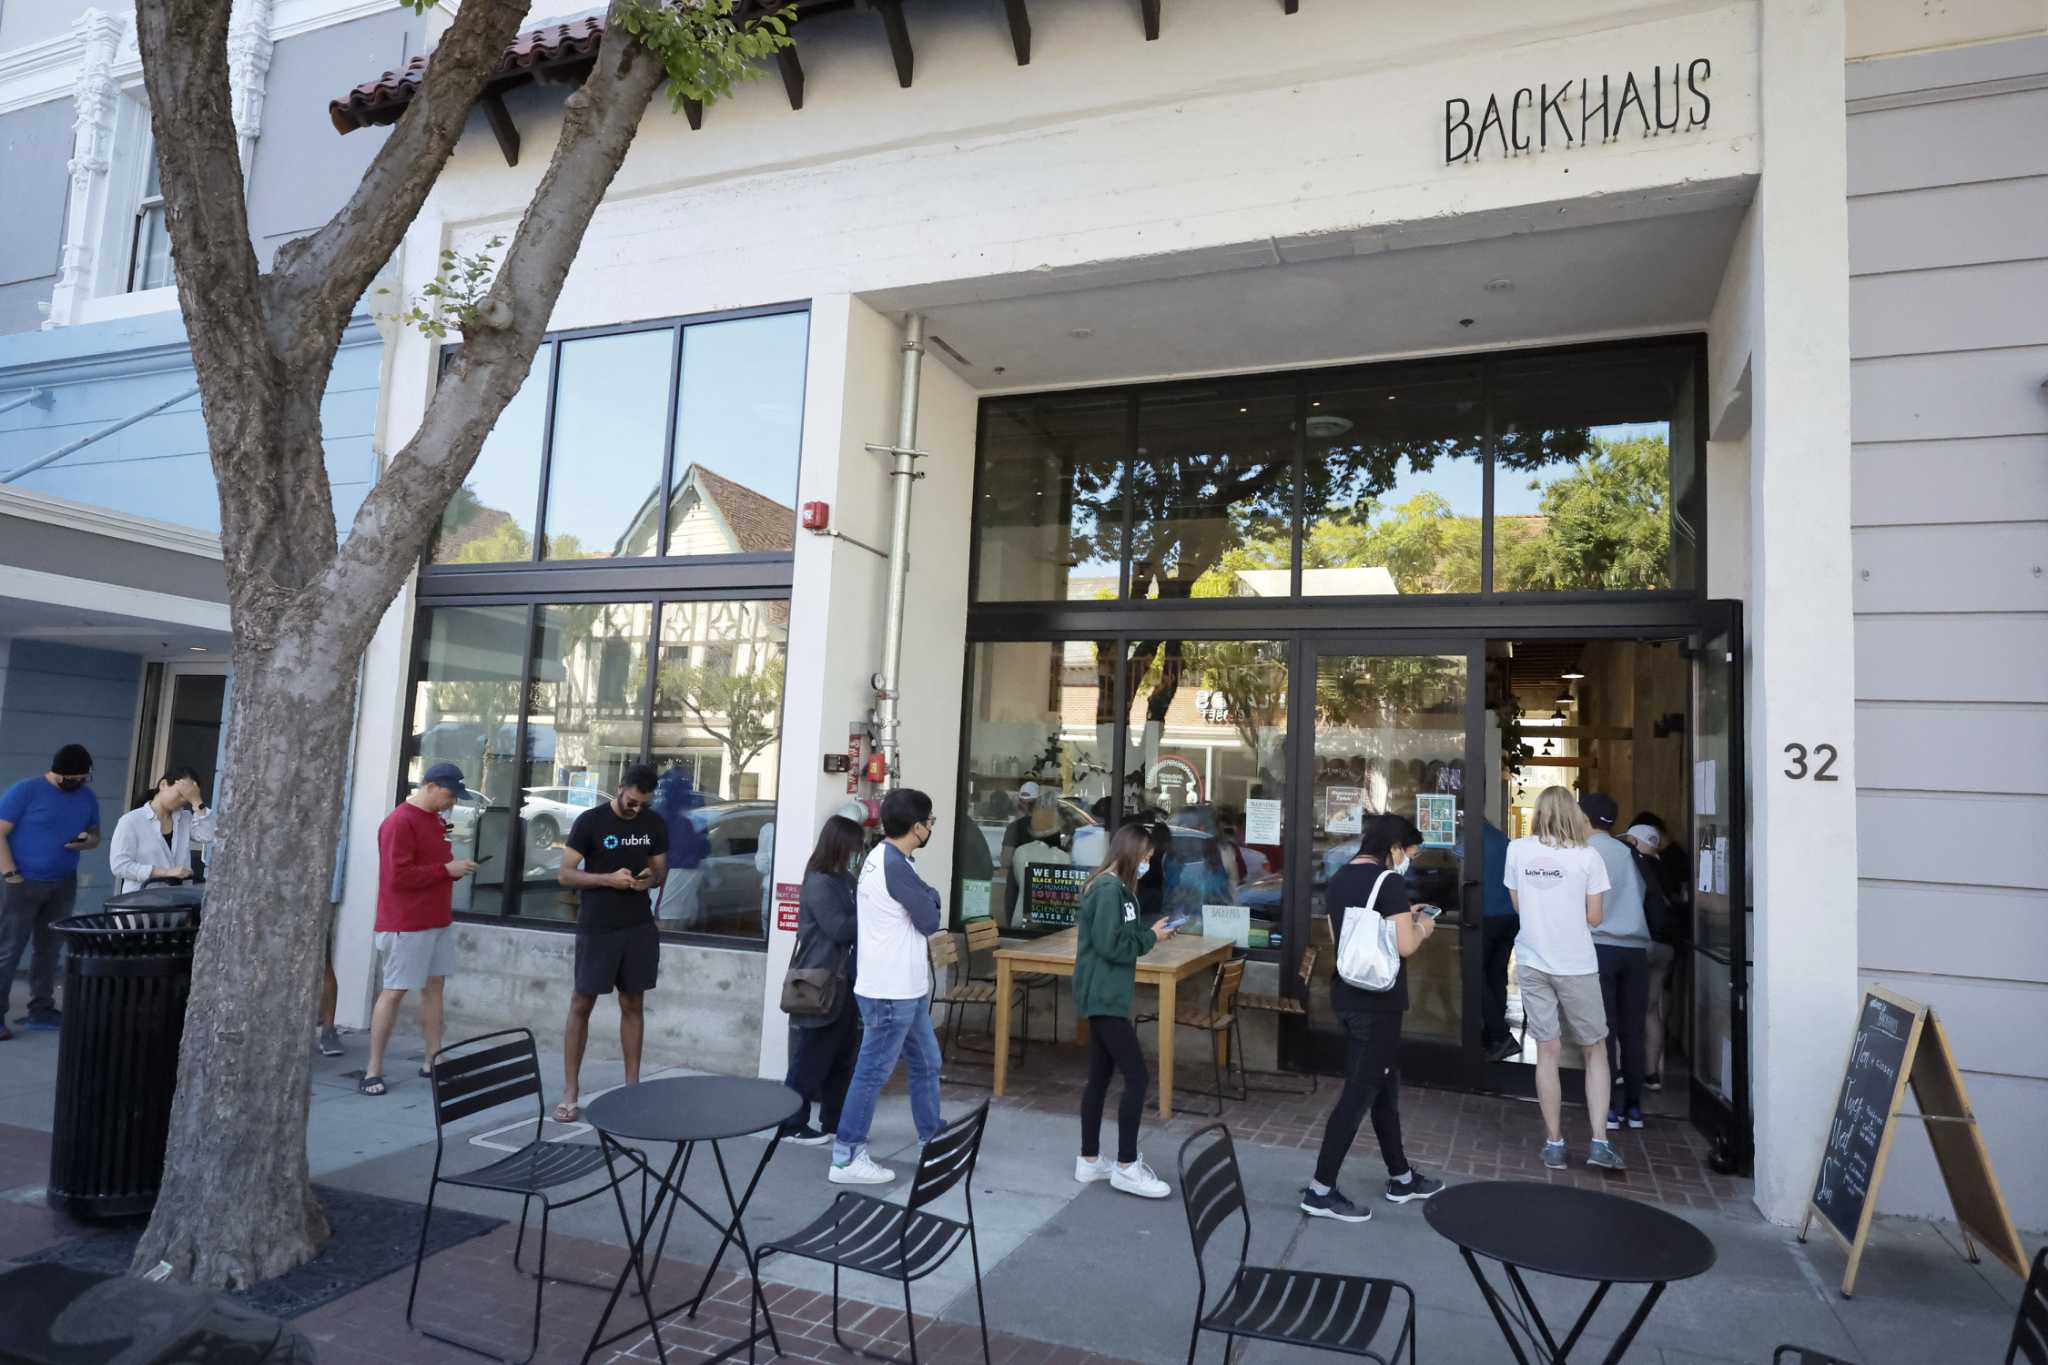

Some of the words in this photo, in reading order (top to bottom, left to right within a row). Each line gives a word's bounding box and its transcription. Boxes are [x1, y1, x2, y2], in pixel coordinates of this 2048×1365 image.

[1446, 58, 1711, 163] BACKHAUS
[1784, 742, 1838, 781] 32
[621, 834, 651, 846] rubrik
[1033, 868, 1050, 878] WE
[1031, 912, 1061, 920] WATER
